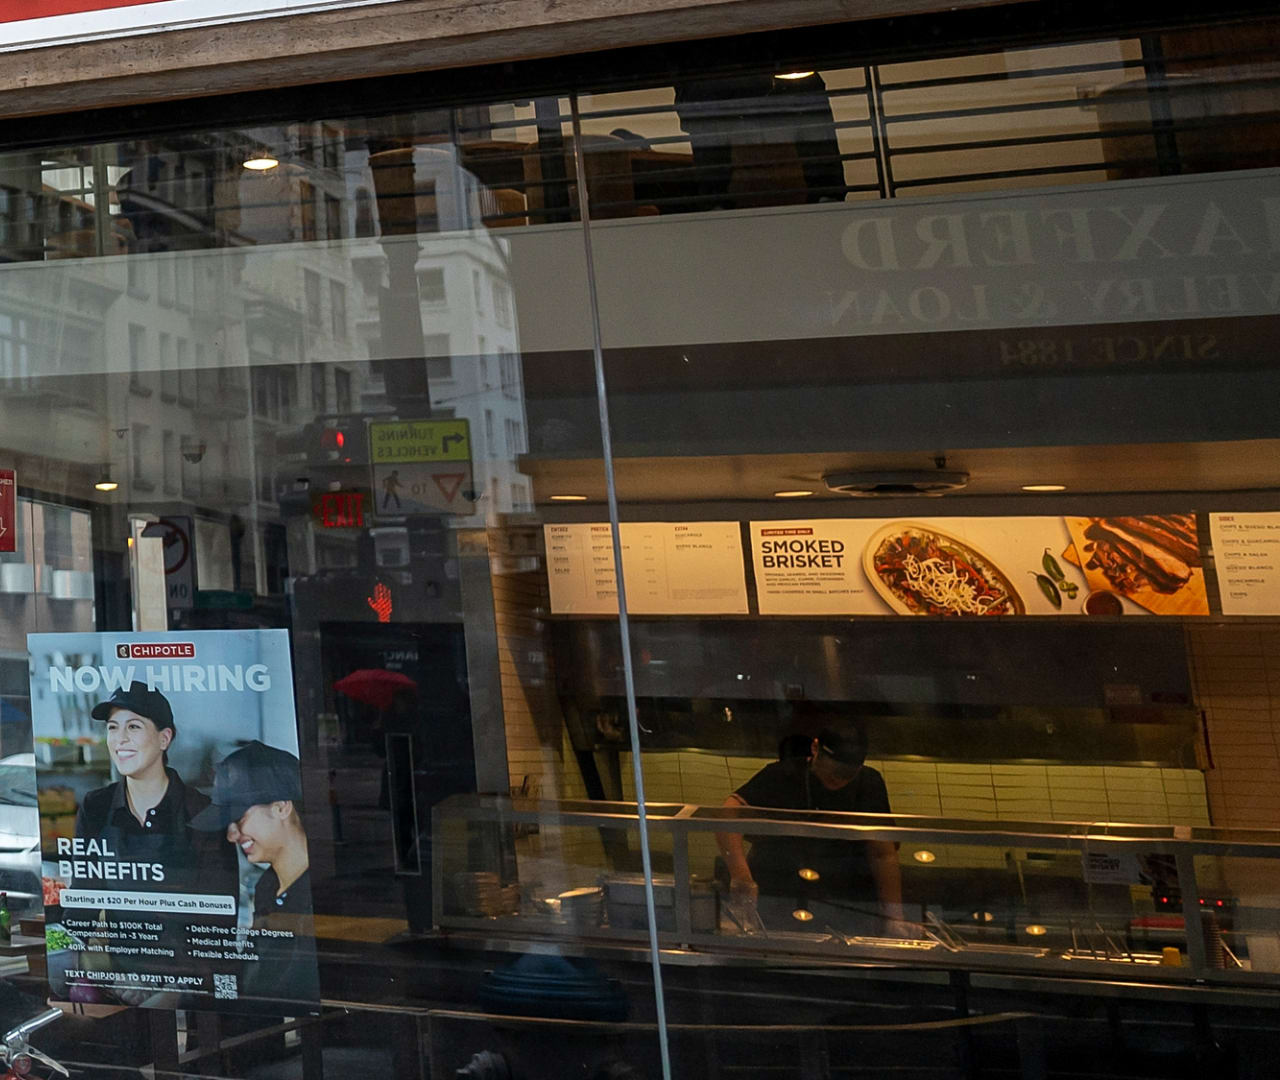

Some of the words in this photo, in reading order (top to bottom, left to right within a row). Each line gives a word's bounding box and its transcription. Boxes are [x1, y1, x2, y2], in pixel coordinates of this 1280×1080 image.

[321, 493, 364, 527] EXIT
[762, 540, 845, 553] SMOKED
[763, 555, 844, 568] BRISKET
[133, 646, 192, 656] CHIPOTLE
[50, 665, 136, 693] NOW
[147, 664, 272, 693] HIRING
[57, 837, 115, 856] REAL
[58, 860, 165, 882] BENEFITS
[65, 895, 96, 905] Starting
[97, 896, 105, 904] at
[107, 896, 122, 905] $20
[138, 898, 157, 906] Hour
[160, 899, 176, 907] Plus
[178, 900, 197, 908] Cash
[199, 901, 232, 910] Bonuses
[66, 919, 90, 927] Career
[92, 920, 108, 928] Path
[110, 921, 118, 929] to
[120, 921, 143, 929] $100K
[144, 922, 163, 931] Total
[191, 925, 229, 934] Debt-Free
[231, 927, 260, 937] College
[261, 929, 294, 938] Degrees
[66, 929, 119, 939] Compensation
[139, 932, 159, 941] Years
[192, 938, 221, 946] Medical
[223, 939, 255, 948] Benefits
[68, 944, 86, 952] 401K
[88, 944, 104, 952] with
[104, 945, 139, 954] Employer
[141, 947, 175, 957] Matching
[193, 950, 222, 959] Flexible
[224, 951, 259, 960] Schedule
[64, 969, 85, 978] TEXT
[87, 971, 126, 980] CHIPJOBS
[127, 973, 139, 981] TO
[140, 974, 162, 982] 97211
[164, 976, 175, 984] TO
[177, 976, 203, 985] APPLY
